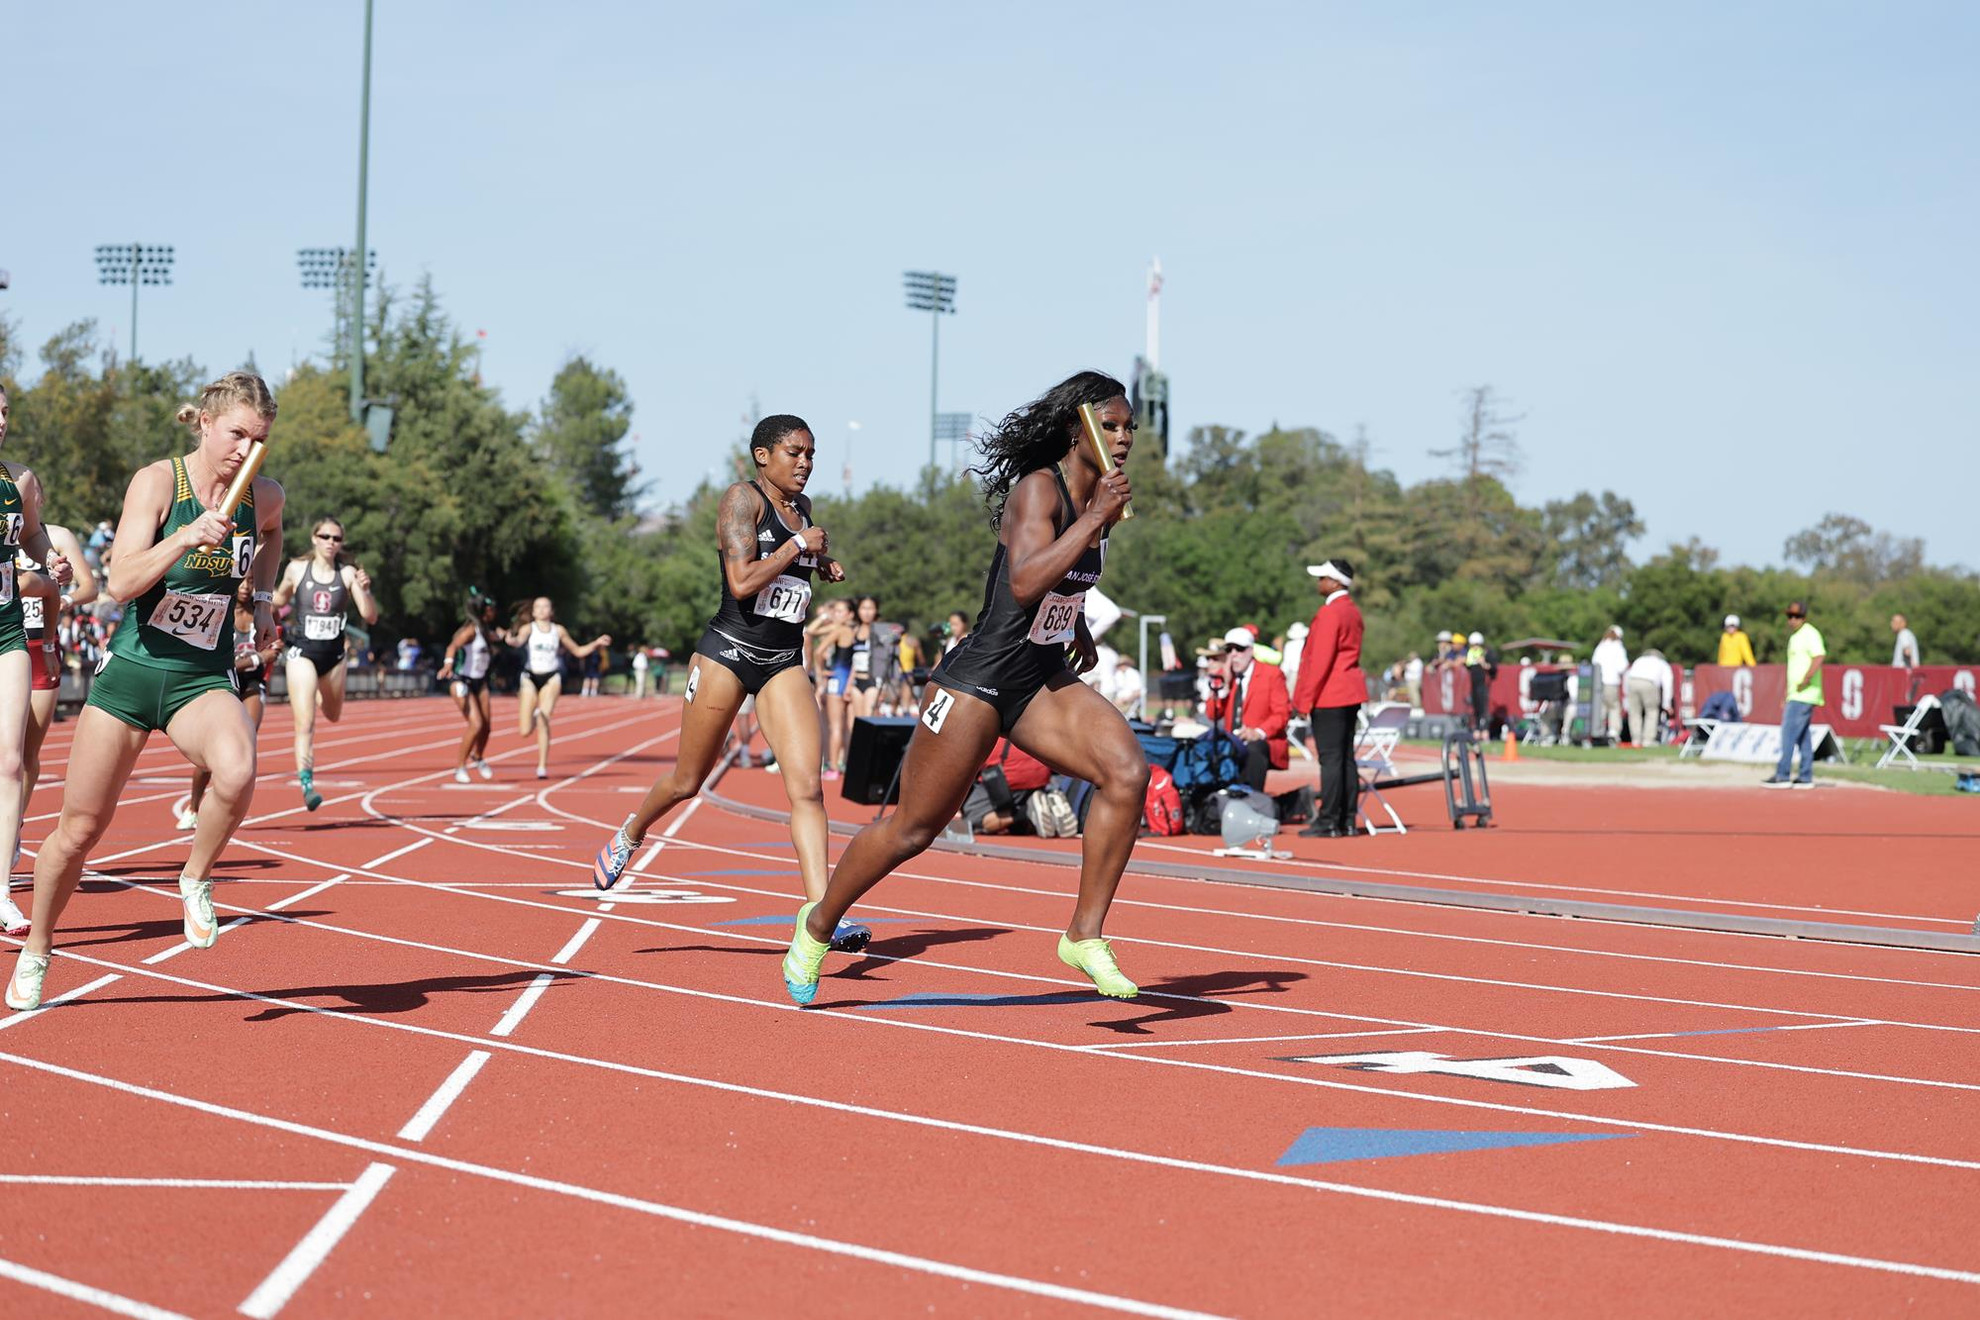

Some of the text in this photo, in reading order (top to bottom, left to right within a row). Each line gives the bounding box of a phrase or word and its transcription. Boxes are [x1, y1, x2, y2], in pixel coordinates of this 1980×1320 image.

[10, 515, 21, 545] 6
[184, 555, 231, 571] NDSU
[239, 539, 251, 577] 6
[770, 586, 803, 614] 677
[169, 599, 216, 633] 534
[1043, 604, 1073, 631] 689
[976, 686, 999, 697] adidas
[1842, 669, 1863, 720] S
[927, 695, 949, 727] 4
[1267, 1050, 1640, 1091] 4
